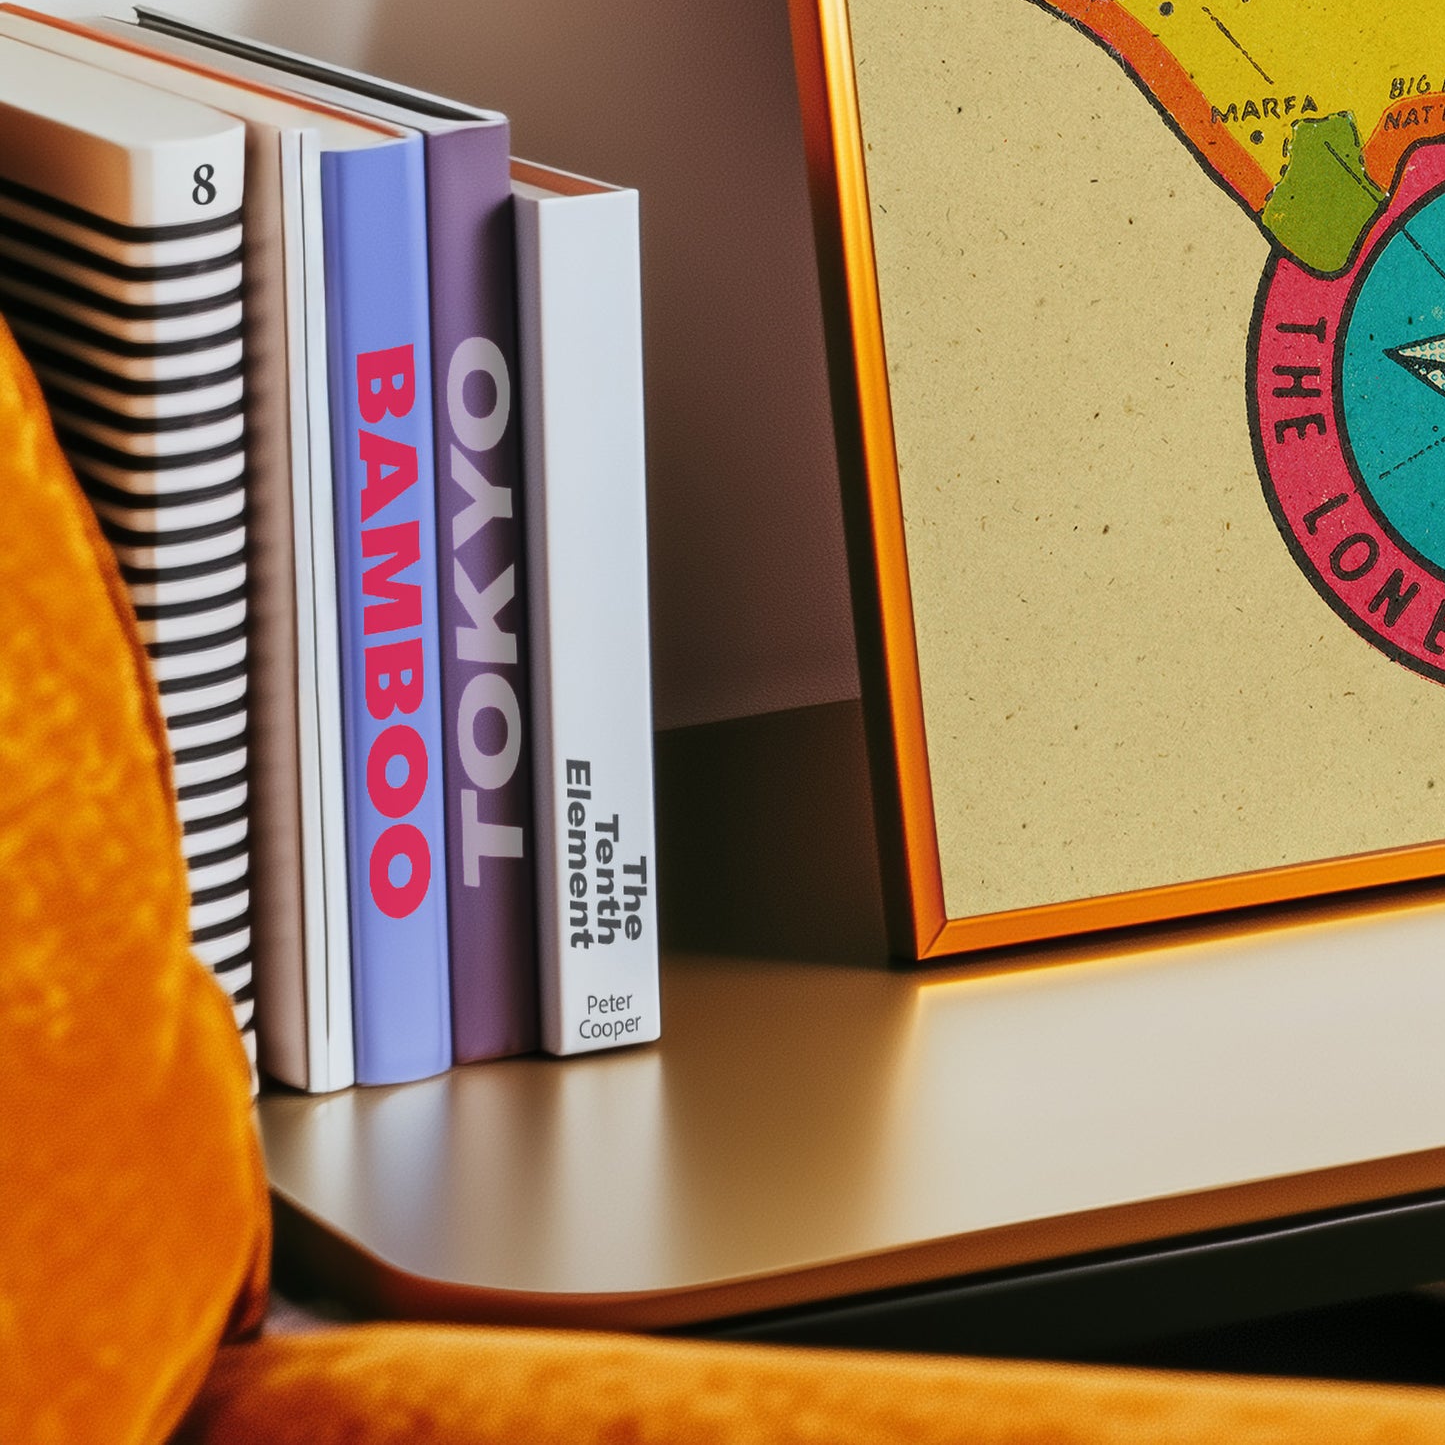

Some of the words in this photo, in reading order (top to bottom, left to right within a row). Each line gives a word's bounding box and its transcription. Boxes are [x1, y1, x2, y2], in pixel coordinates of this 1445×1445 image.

[1211, 95, 1318, 124] MARFA
[1390, 75, 1431, 100] BIG
[191, 163, 217, 206] 8
[1272, 317, 1328, 444] THE
[356, 343, 431, 919] BAMBOO
[447, 336, 524, 887] TOKYO
[565, 759, 593, 950] Element
[594, 814, 622, 945] Tenth
[622, 855, 647, 943] The
[578, 1013, 641, 1041] Cooper
[586, 992, 633, 1015] Peter
